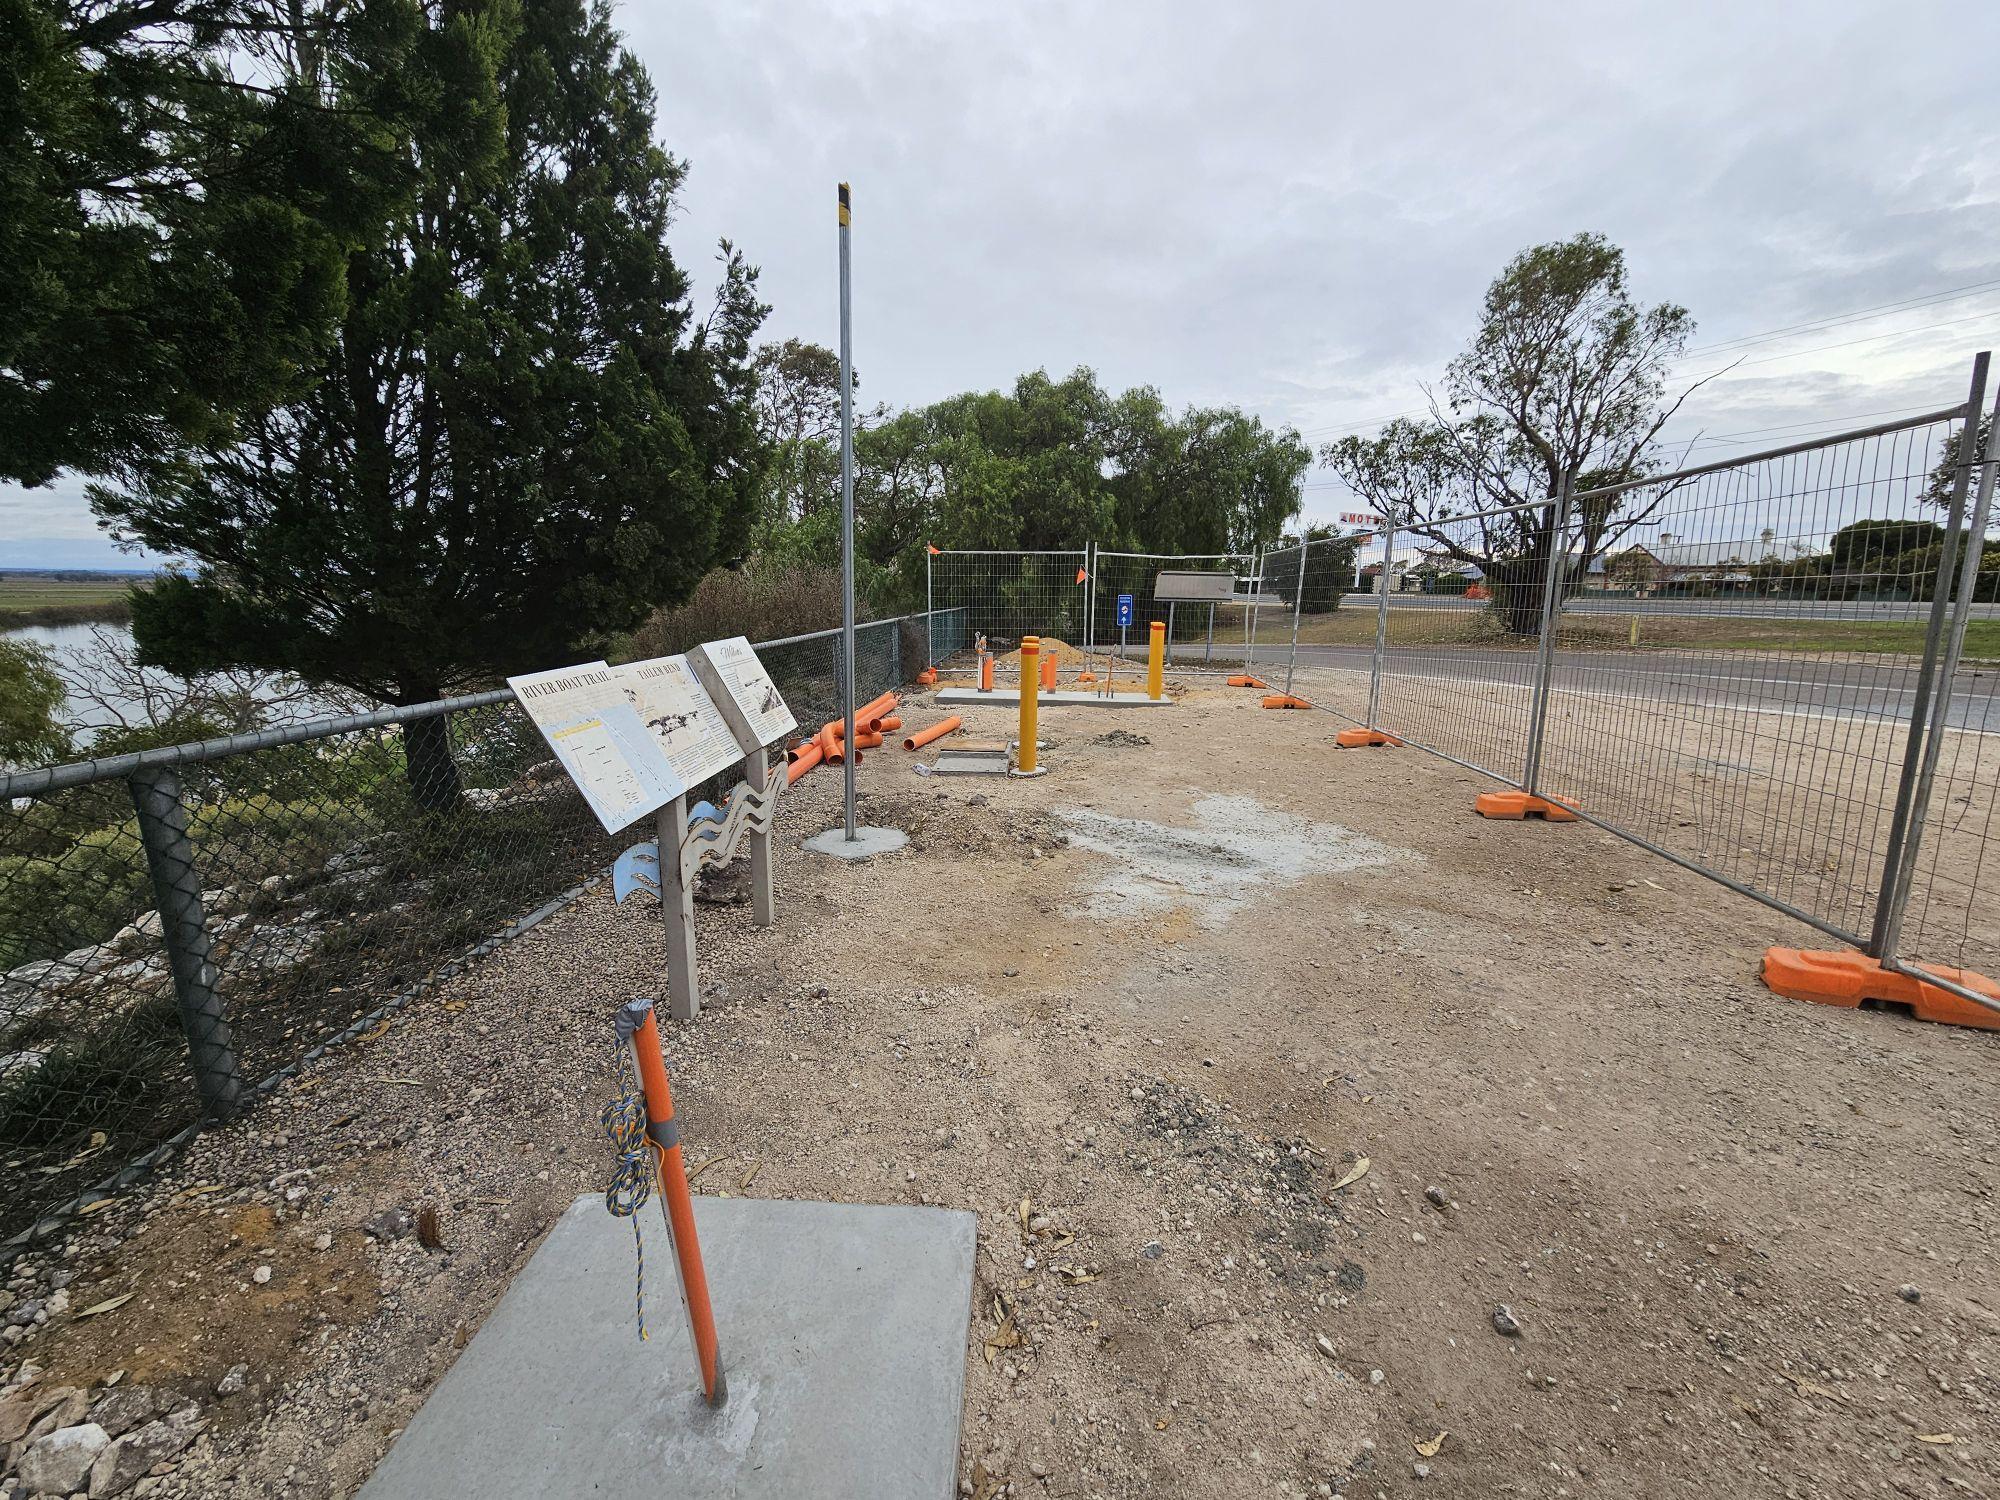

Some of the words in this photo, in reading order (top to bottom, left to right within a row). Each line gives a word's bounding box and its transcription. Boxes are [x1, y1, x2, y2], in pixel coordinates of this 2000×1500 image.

[637, 666, 663, 680] TAILEM
[663, 663, 681, 675] BEND
[521, 681, 558, 699] RIVER
[555, 676, 583, 692] BOAT
[581, 671, 611, 686] TRAIL
